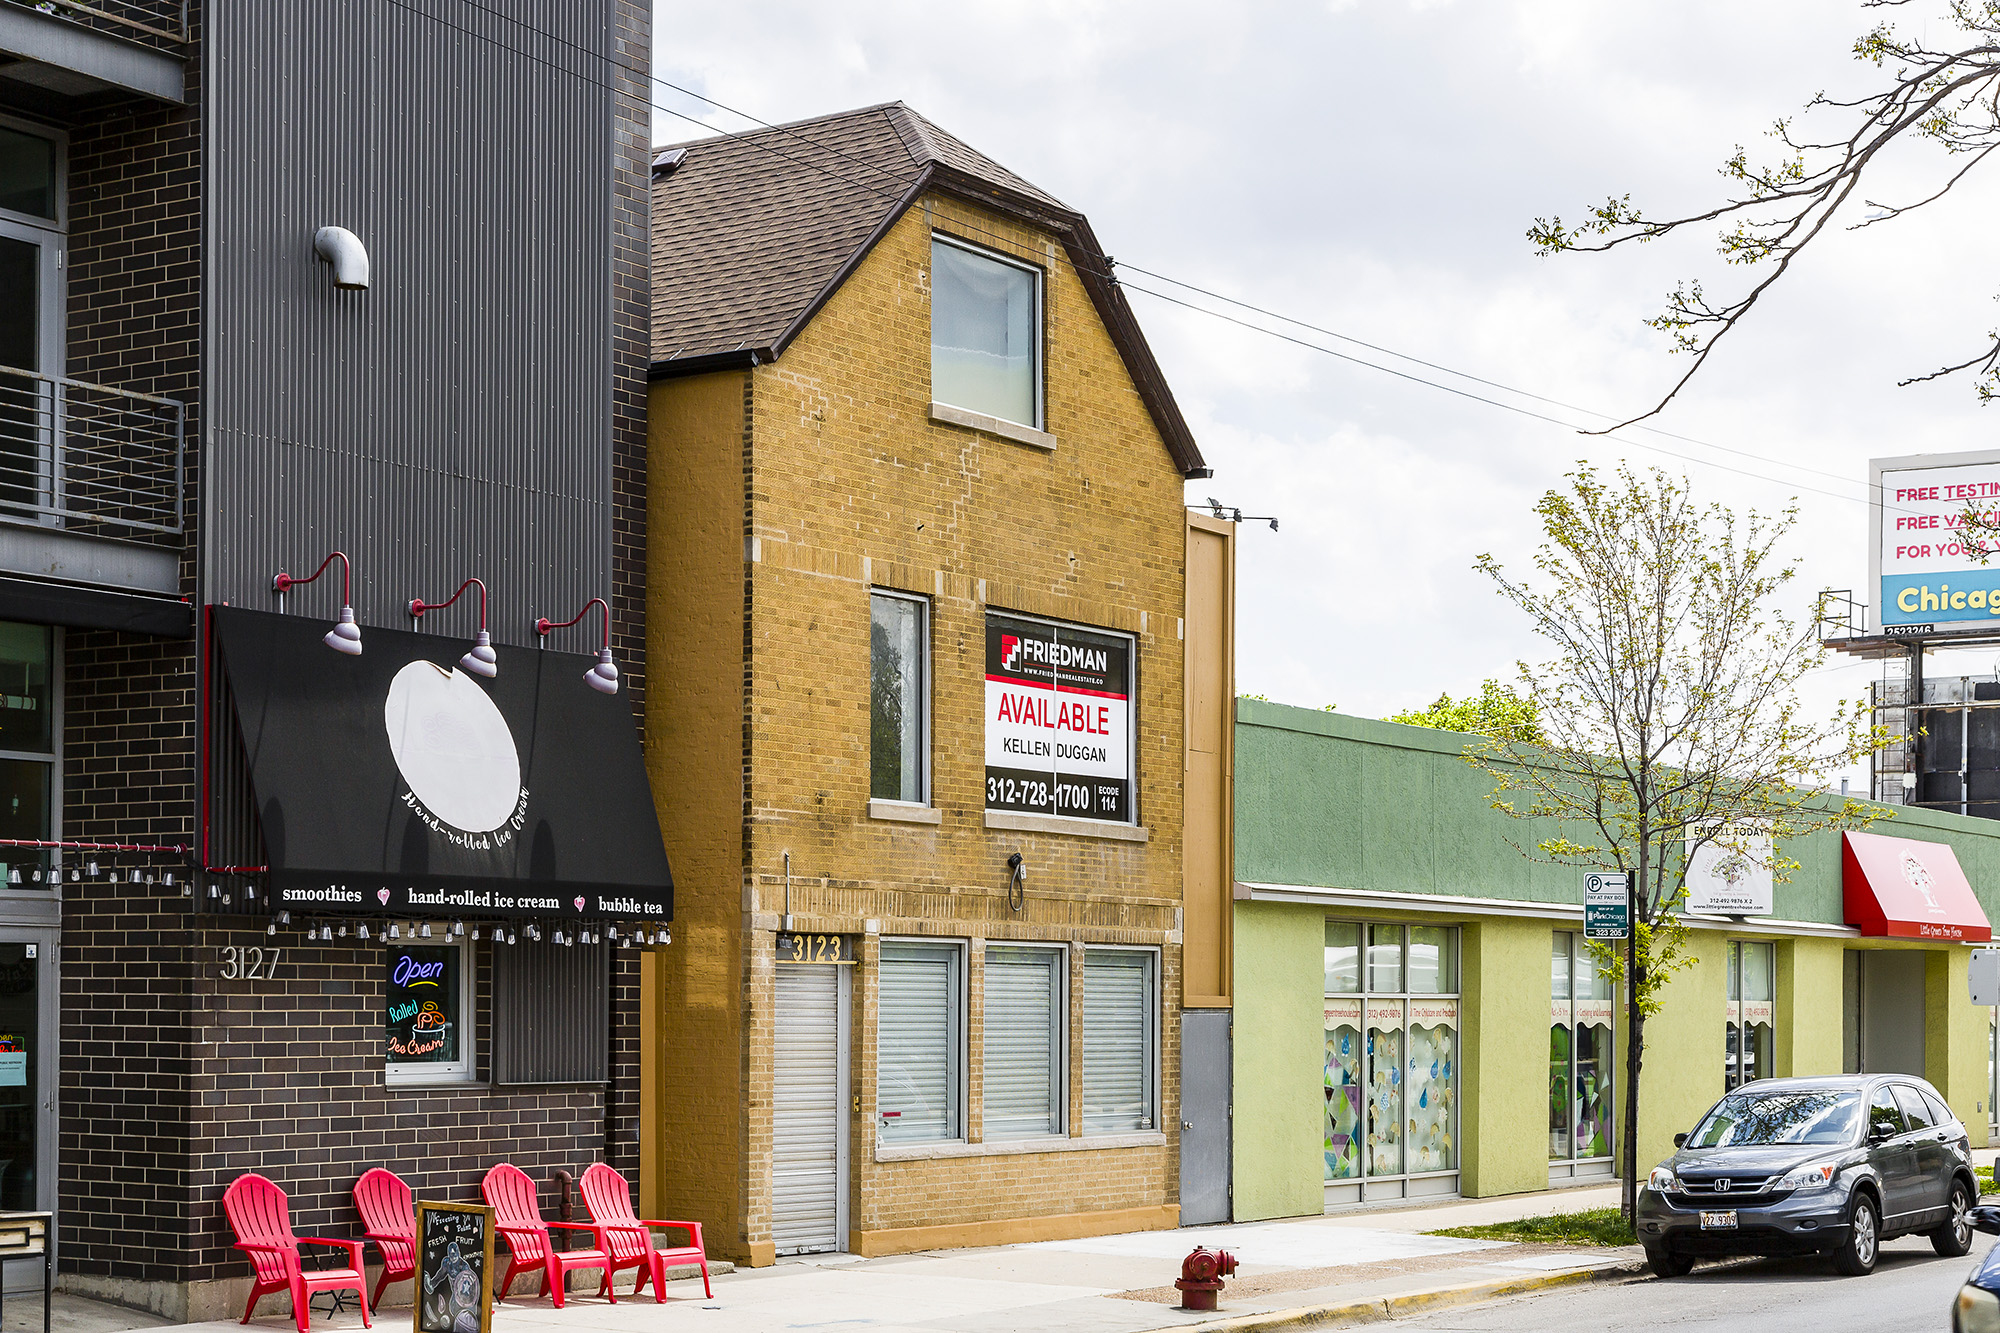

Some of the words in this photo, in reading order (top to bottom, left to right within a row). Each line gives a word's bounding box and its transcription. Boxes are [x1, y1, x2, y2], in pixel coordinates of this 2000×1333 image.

[1896, 486, 1940, 502] FREE
[1896, 516, 1940, 530] FREE
[1896, 545, 1931, 560] FOR
[1935, 542, 1972, 557] YOU
[1023, 638, 1107, 672] FRIEDMAN
[998, 692, 1110, 736] AVAILABLE
[1003, 737, 1050, 757] KELLEN
[1056, 743, 1106, 762] DUGGAN
[987, 776, 1090, 810] 312-728-1700
[1098, 784, 1120, 796] ECODE
[1101, 796, 1116, 812] 114
[1732, 827, 1764, 836] TODAY
[282, 885, 362, 904] smoothies
[408, 888, 492, 908] hand-rolled
[494, 891, 514, 908] ice
[517, 895, 560, 910] cream
[598, 896, 640, 914] bubble
[644, 898, 664, 915] tea
[792, 934, 841, 962] 3123
[220, 946, 280, 979] 3127
[394, 956, 444, 988] Open
[389, 999, 418, 1023] Rolled
[1367, 1009, 1378, 1019] (312)
[388, 1036, 406, 1054] Ice
[407, 1039, 444, 1055] Cream
[1718, 1216, 1736, 1225] 9309
[428, 1234, 448, 1248] FRESH
[455, 1235, 475, 1246] FRUIT
